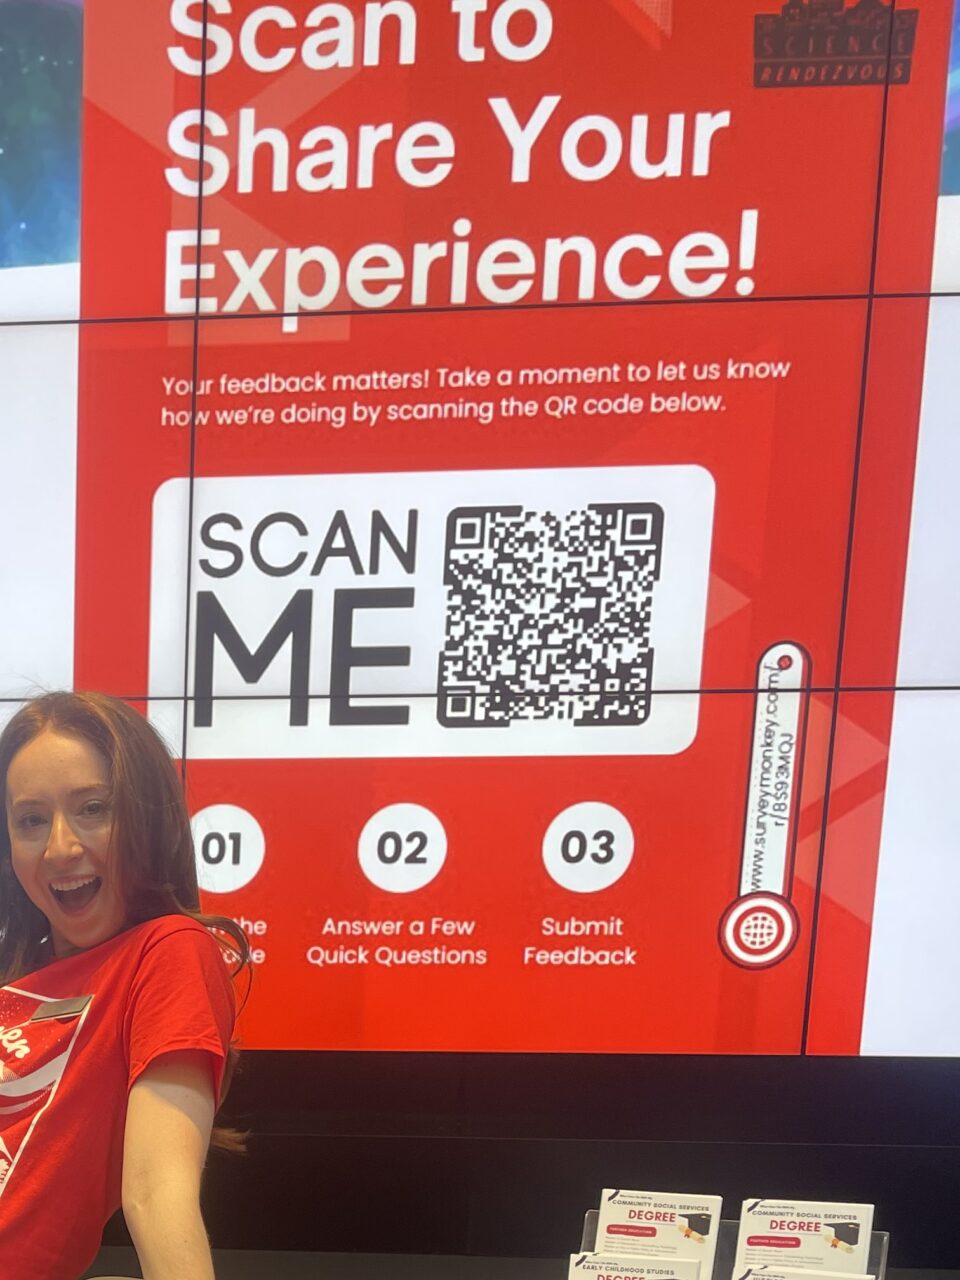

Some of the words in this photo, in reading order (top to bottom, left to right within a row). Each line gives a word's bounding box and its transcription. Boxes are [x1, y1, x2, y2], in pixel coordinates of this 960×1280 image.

[167, 0, 416, 76] Scan
[457, 0, 552, 62] to
[761, 63, 903, 82] RENDEZVOUS
[165, 109, 455, 197] Share
[488, 95, 730, 184] Your
[165, 209, 760, 333] Experience!
[162, 376, 213, 396] Your
[220, 372, 326, 394] feedback
[332, 369, 429, 391] matters!
[437, 367, 491, 388] Take
[497, 369, 513, 386] a
[519, 364, 621, 385] moment
[628, 364, 651, 382] to
[657, 360, 686, 381] let
[693, 363, 720, 379] us
[727, 358, 790, 379] know
[161, 406, 209, 426] how
[280, 403, 346, 428] doing
[353, 401, 381, 426] by
[387, 398, 493, 423] scanning
[500, 396, 538, 417] the
[544, 396, 576, 419] QR
[583, 393, 643, 415] code
[650, 392, 726, 413] below.
[198, 509, 418, 578] SCAN
[194, 587, 415, 727] ME
[202, 831, 241, 865] 01
[377, 831, 428, 865] 02
[560, 830, 615, 865] 03
[322, 917, 401, 936] Answer
[409, 920, 424, 936] a
[430, 917, 475, 936] Few
[542, 917, 624, 936] Submit
[306, 945, 368, 966] Quick
[375, 945, 487, 966] Questions
[524, 946, 636, 966] Feedback
[612, 1199, 652, 1208] COMMUNITY
[679, 1204, 710, 1212] SERVICES
[628, 1209, 676, 1222] DEGREE
[752, 1210, 794, 1218] COMMUNITY
[824, 1213, 857, 1221] SERVICES
[770, 1219, 821, 1232] DEGREE
[605, 1265, 645, 1274] CHILDHOOD
